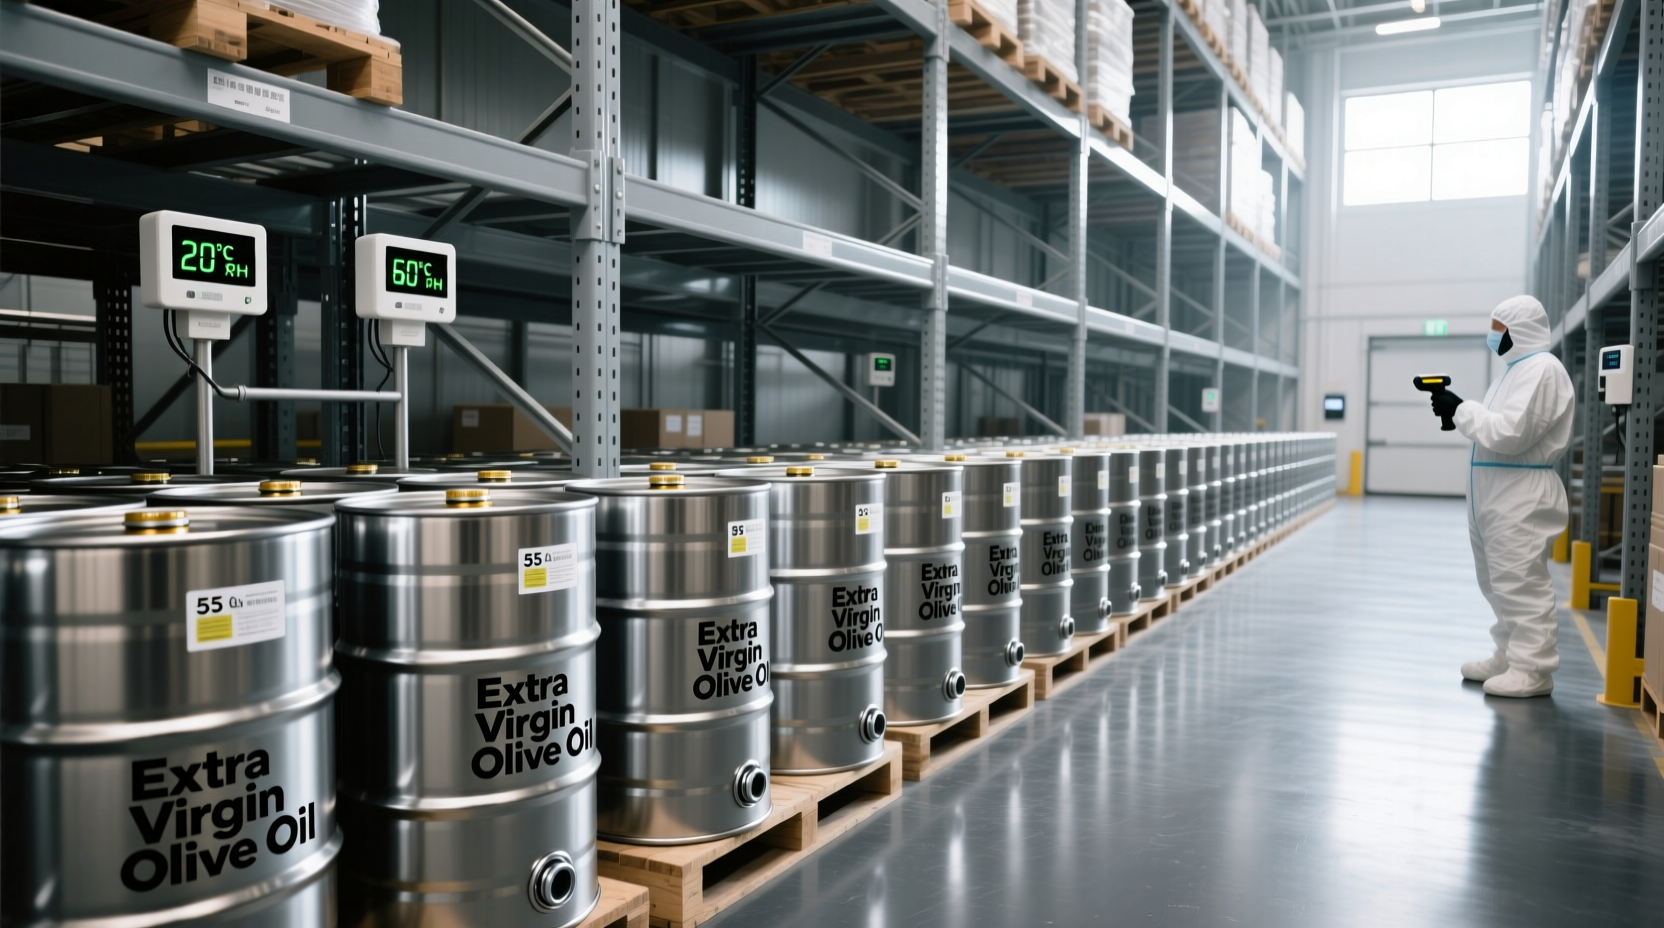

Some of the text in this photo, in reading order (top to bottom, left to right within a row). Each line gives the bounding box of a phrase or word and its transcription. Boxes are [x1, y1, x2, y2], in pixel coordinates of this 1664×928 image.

[225, 263, 249, 279] RH
[523, 552, 543, 568] 55
[921, 563, 958, 581] Extra
[196, 595, 224, 615] 55
[832, 585, 878, 607] Extra
[831, 605, 880, 630] Virgin
[918, 600, 957, 621] Olive
[698, 619, 757, 646] Extra
[828, 628, 874, 652] Olive
[697, 640, 762, 672] Virgin
[477, 673, 568, 709] Extra
[692, 671, 753, 700] Olive
[474, 700, 575, 743] Virgin
[471, 718, 593, 780] Olive Oil
[132, 749, 270, 802] Extra
[129, 782, 285, 845] Virgin
[120, 801, 316, 893] Olive Oil
